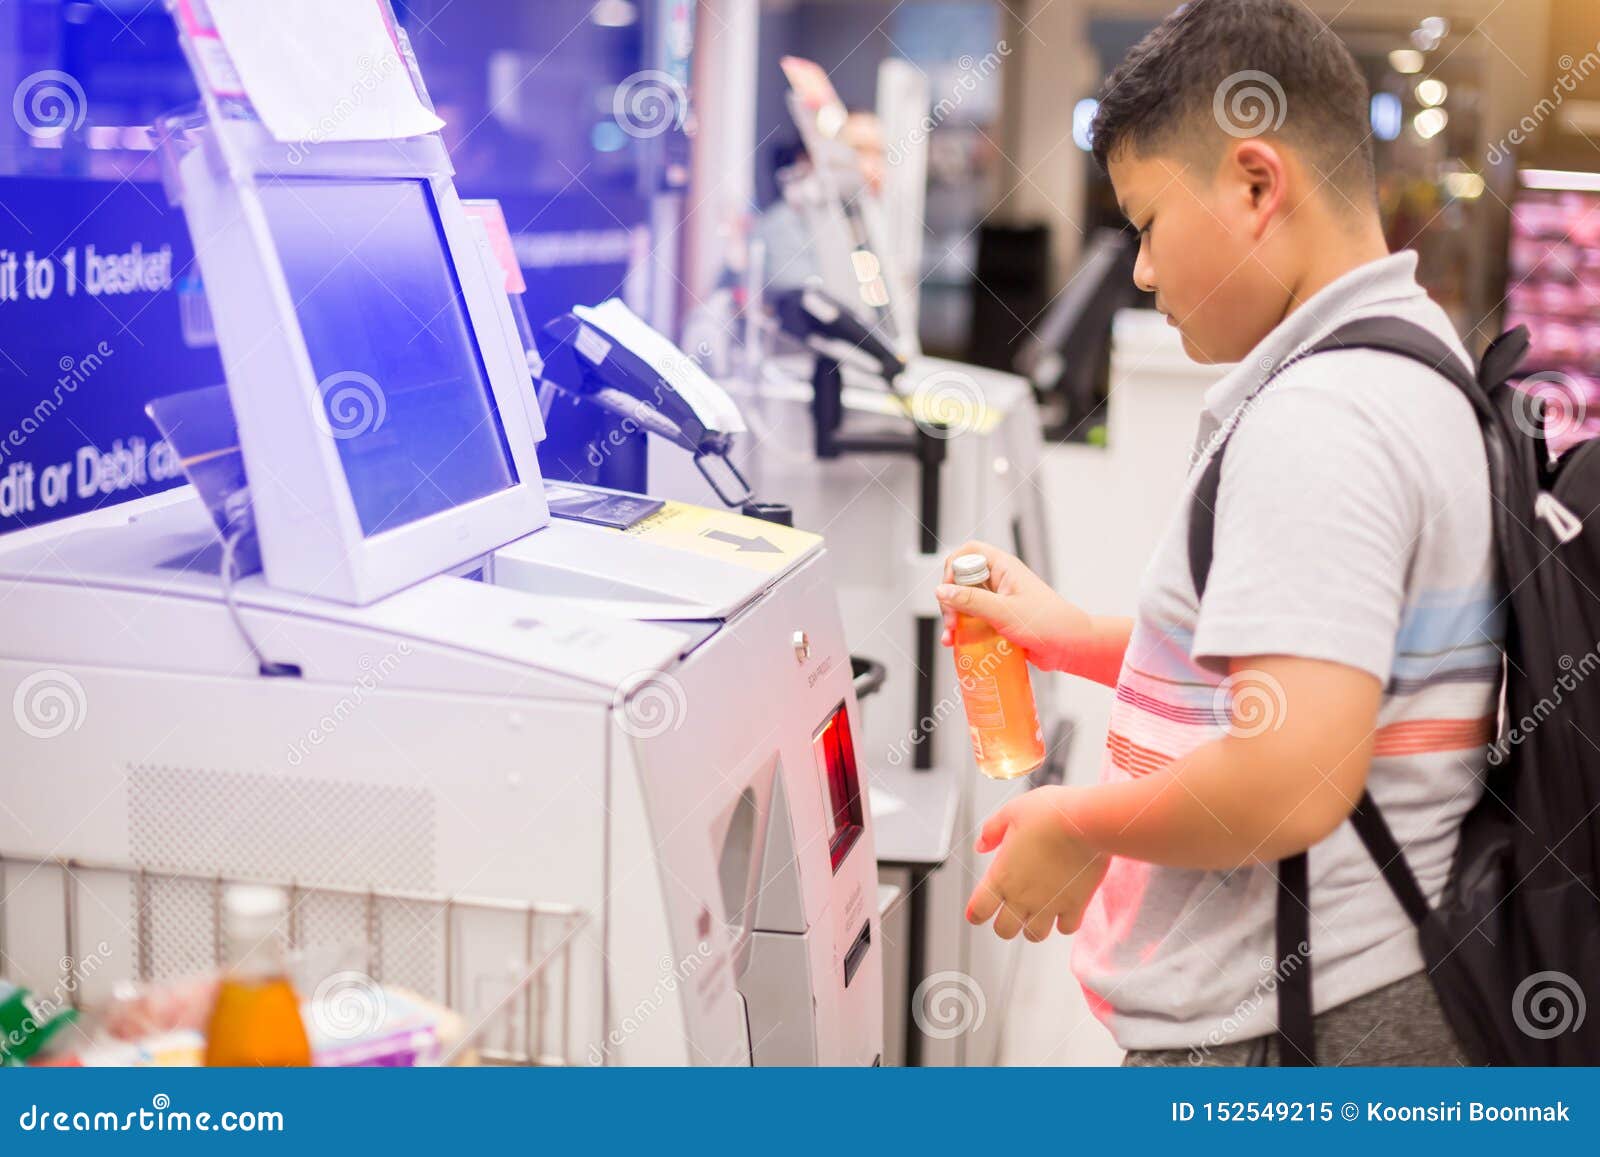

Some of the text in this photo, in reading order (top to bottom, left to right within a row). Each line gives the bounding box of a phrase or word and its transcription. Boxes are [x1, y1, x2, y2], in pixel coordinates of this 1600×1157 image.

[25, 250, 55, 300] to
[63, 246, 77, 297] 1
[85, 242, 172, 297] basket
[40, 461, 72, 507] or
[76, 436, 148, 498] Debit
